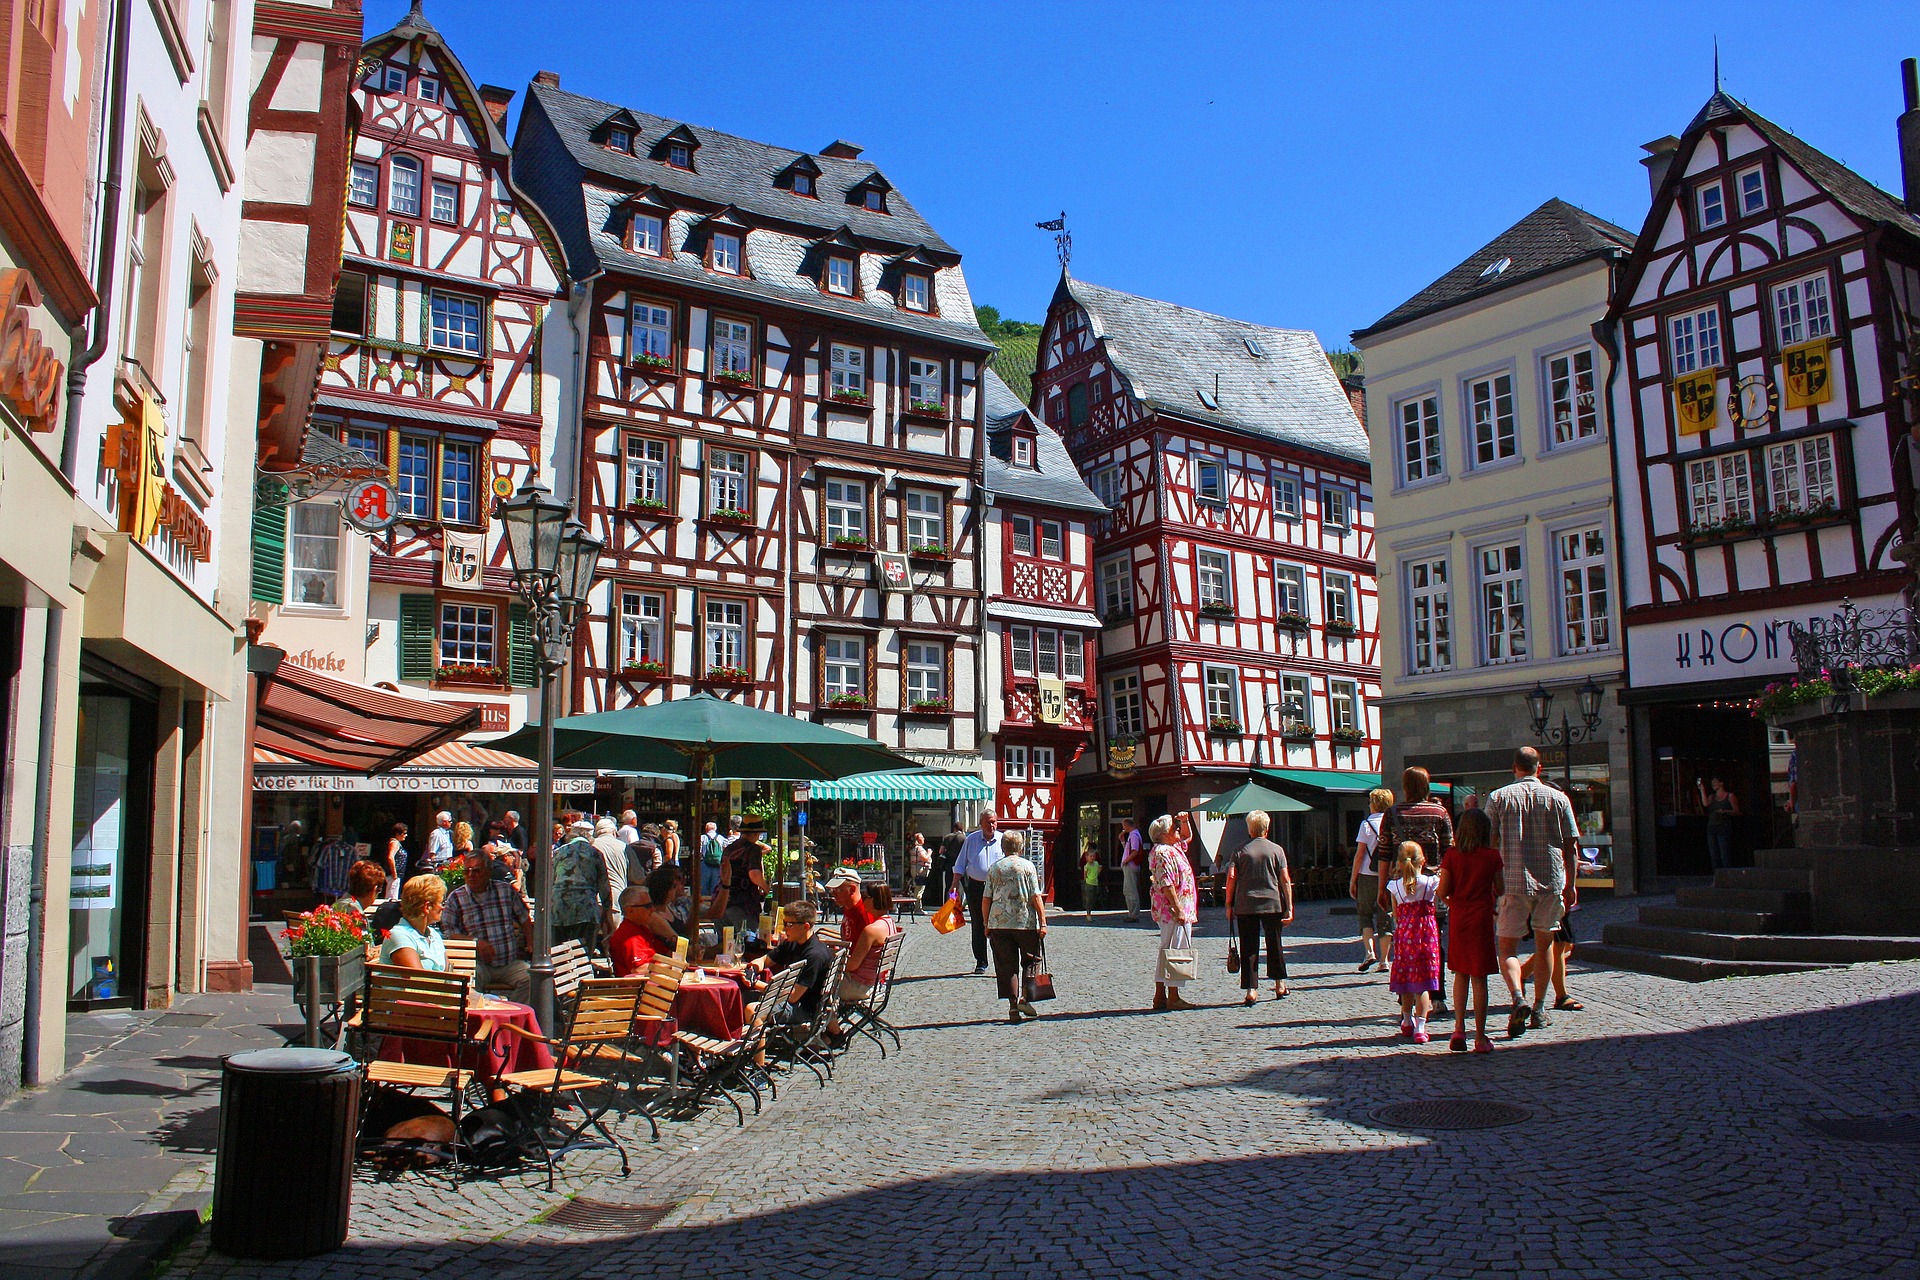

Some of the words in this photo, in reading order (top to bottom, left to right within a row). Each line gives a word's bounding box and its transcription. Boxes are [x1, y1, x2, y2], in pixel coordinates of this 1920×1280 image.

[1676, 613, 1847, 668] KRONER
[477, 703, 507, 722] ius
[308, 776, 329, 789] für
[333, 776, 354, 790] Ihn
[379, 777, 420, 790] TOTO
[432, 778, 479, 790] LOTTO
[571, 780, 591, 792] Sie
